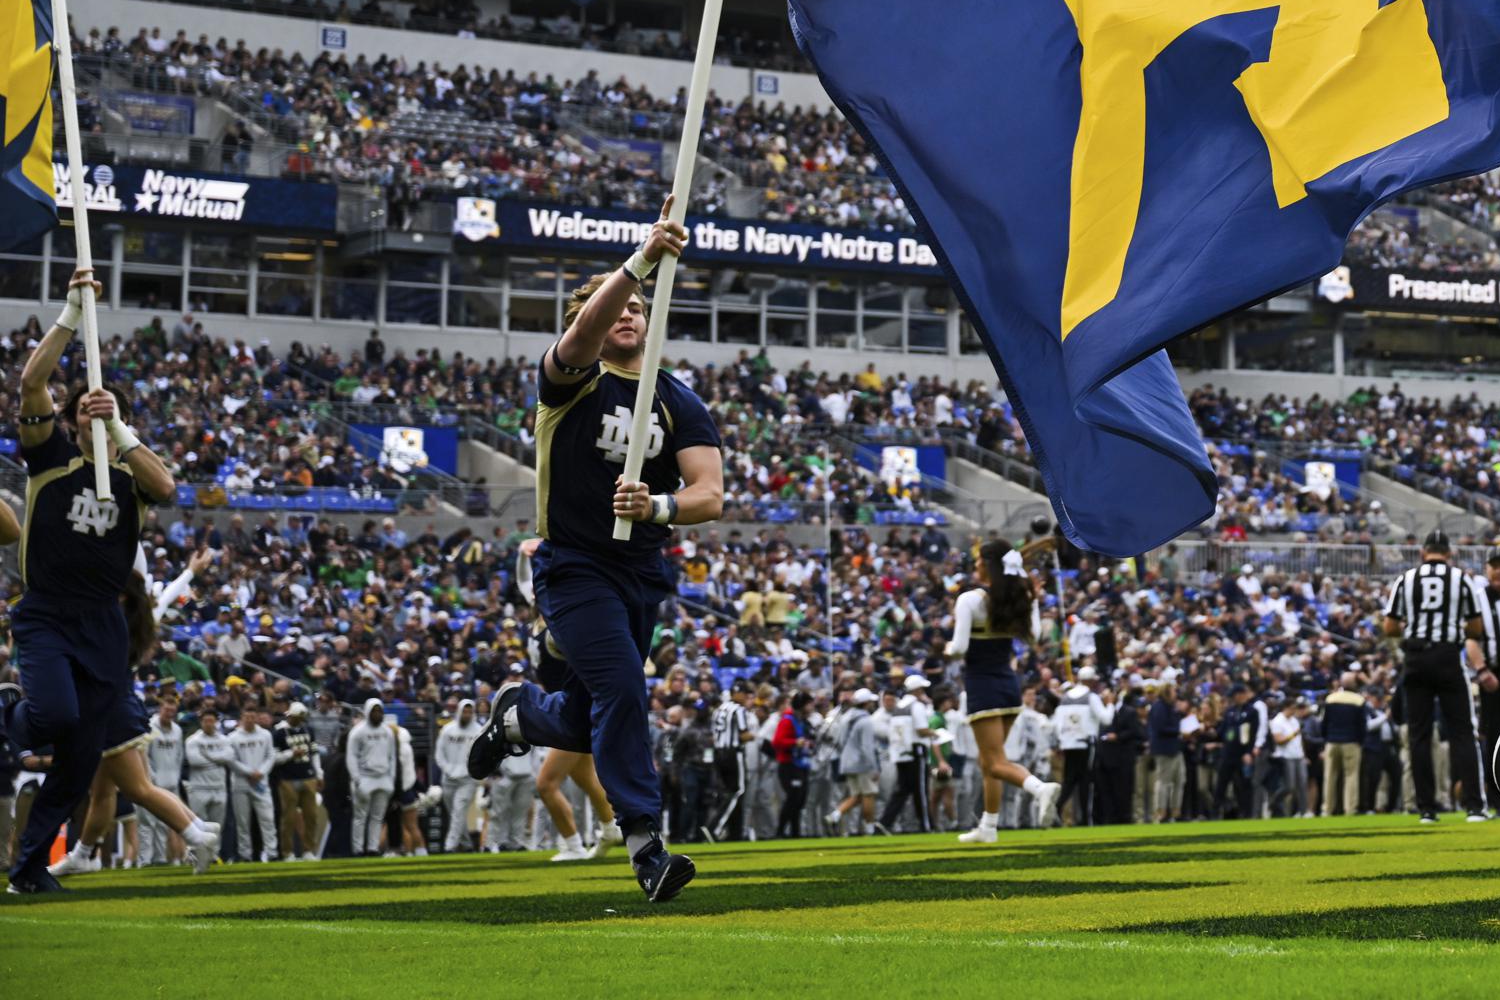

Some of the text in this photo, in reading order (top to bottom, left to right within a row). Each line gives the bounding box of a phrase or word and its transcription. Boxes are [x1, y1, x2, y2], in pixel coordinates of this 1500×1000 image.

[141, 169, 204, 199] Navy
[158, 192, 246, 221] Mutual
[528, 208, 652, 244] Welcome
[694, 222, 739, 251] the
[745, 226, 893, 263] Navy-Notre
[1388, 273, 1496, 303] Presented
[1421, 577, 1444, 609] B
